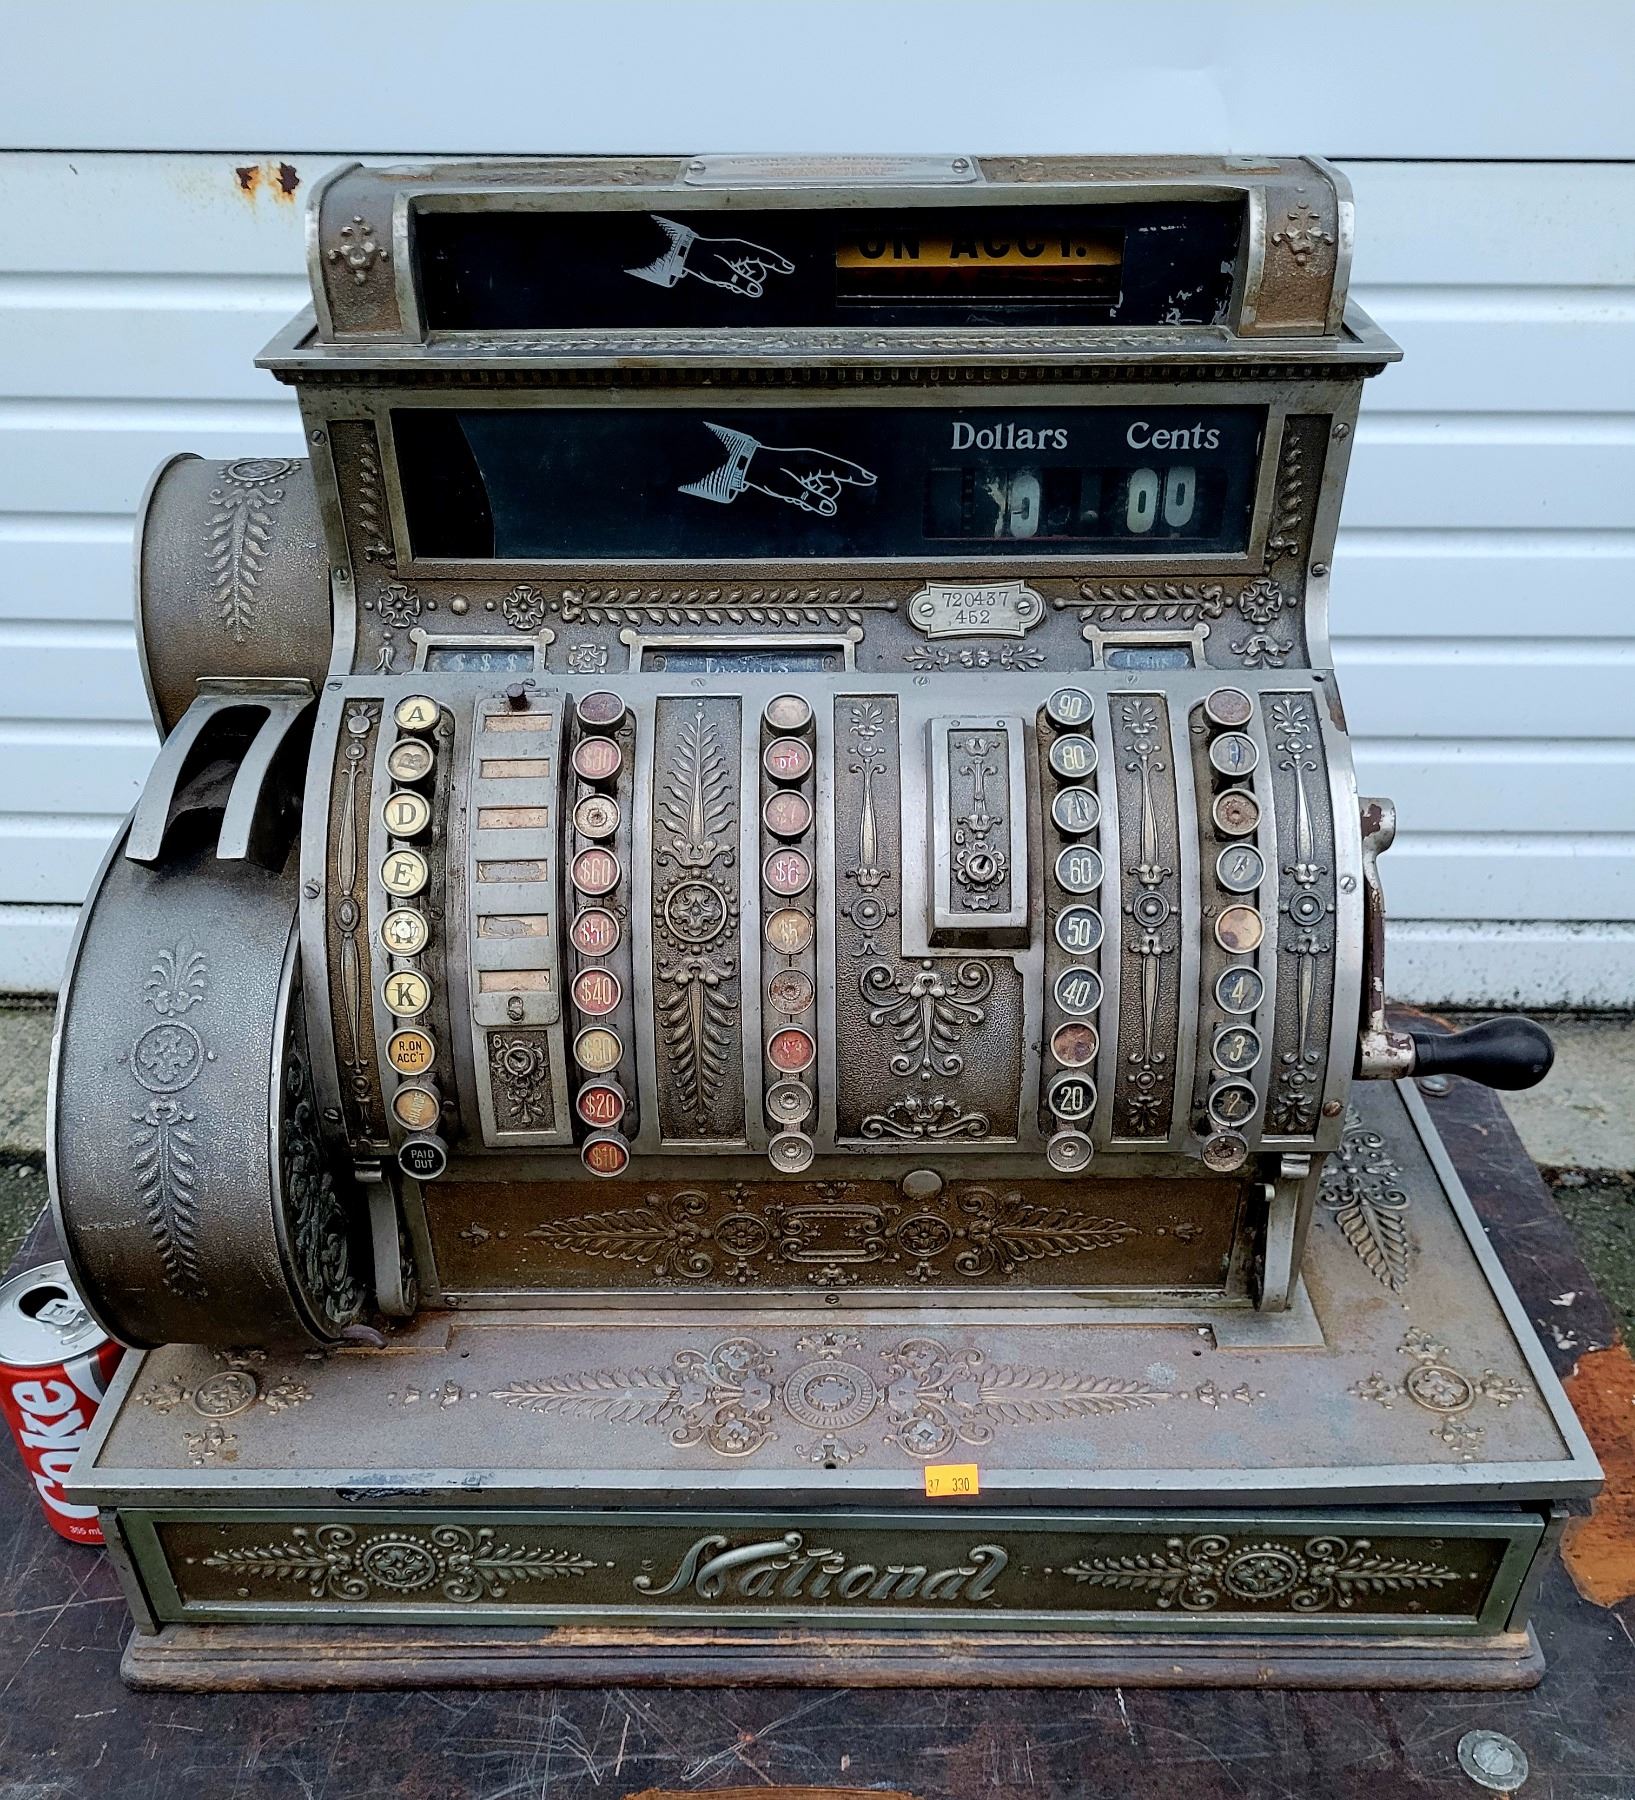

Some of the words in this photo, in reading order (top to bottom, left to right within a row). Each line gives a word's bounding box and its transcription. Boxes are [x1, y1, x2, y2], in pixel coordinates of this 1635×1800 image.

[951, 421, 1068, 450] Dollars
[1126, 420, 1221, 450] Cents
[1126, 465, 1196, 534] 00
[942, 592, 1009, 608] 720437
[955, 610, 990, 625] 452
[406, 705, 427, 723] A
[1058, 695, 1083, 719] 90
[1063, 745, 1085, 770] 80
[396, 802, 418, 826] D
[392, 860, 413, 886] E
[580, 858, 611, 886] $60
[1070, 857, 1092, 884] 60
[1067, 916, 1091, 946] 50
[395, 982, 417, 1008] K
[581, 976, 612, 1005] $40
[1062, 977, 1091, 1008] 40
[1231, 976, 1246, 1004] 4
[1229, 1034, 1246, 1062] 3
[585, 1093, 615, 1119] $20
[1060, 1086, 1084, 1111] 20
[1226, 1090, 1242, 1116] 2
[411, 1150, 435, 1160] PAID
[414, 1159, 434, 1169] OUT
[591, 1146, 618, 1169] $10
[632, 1530, 1009, 1601] National
